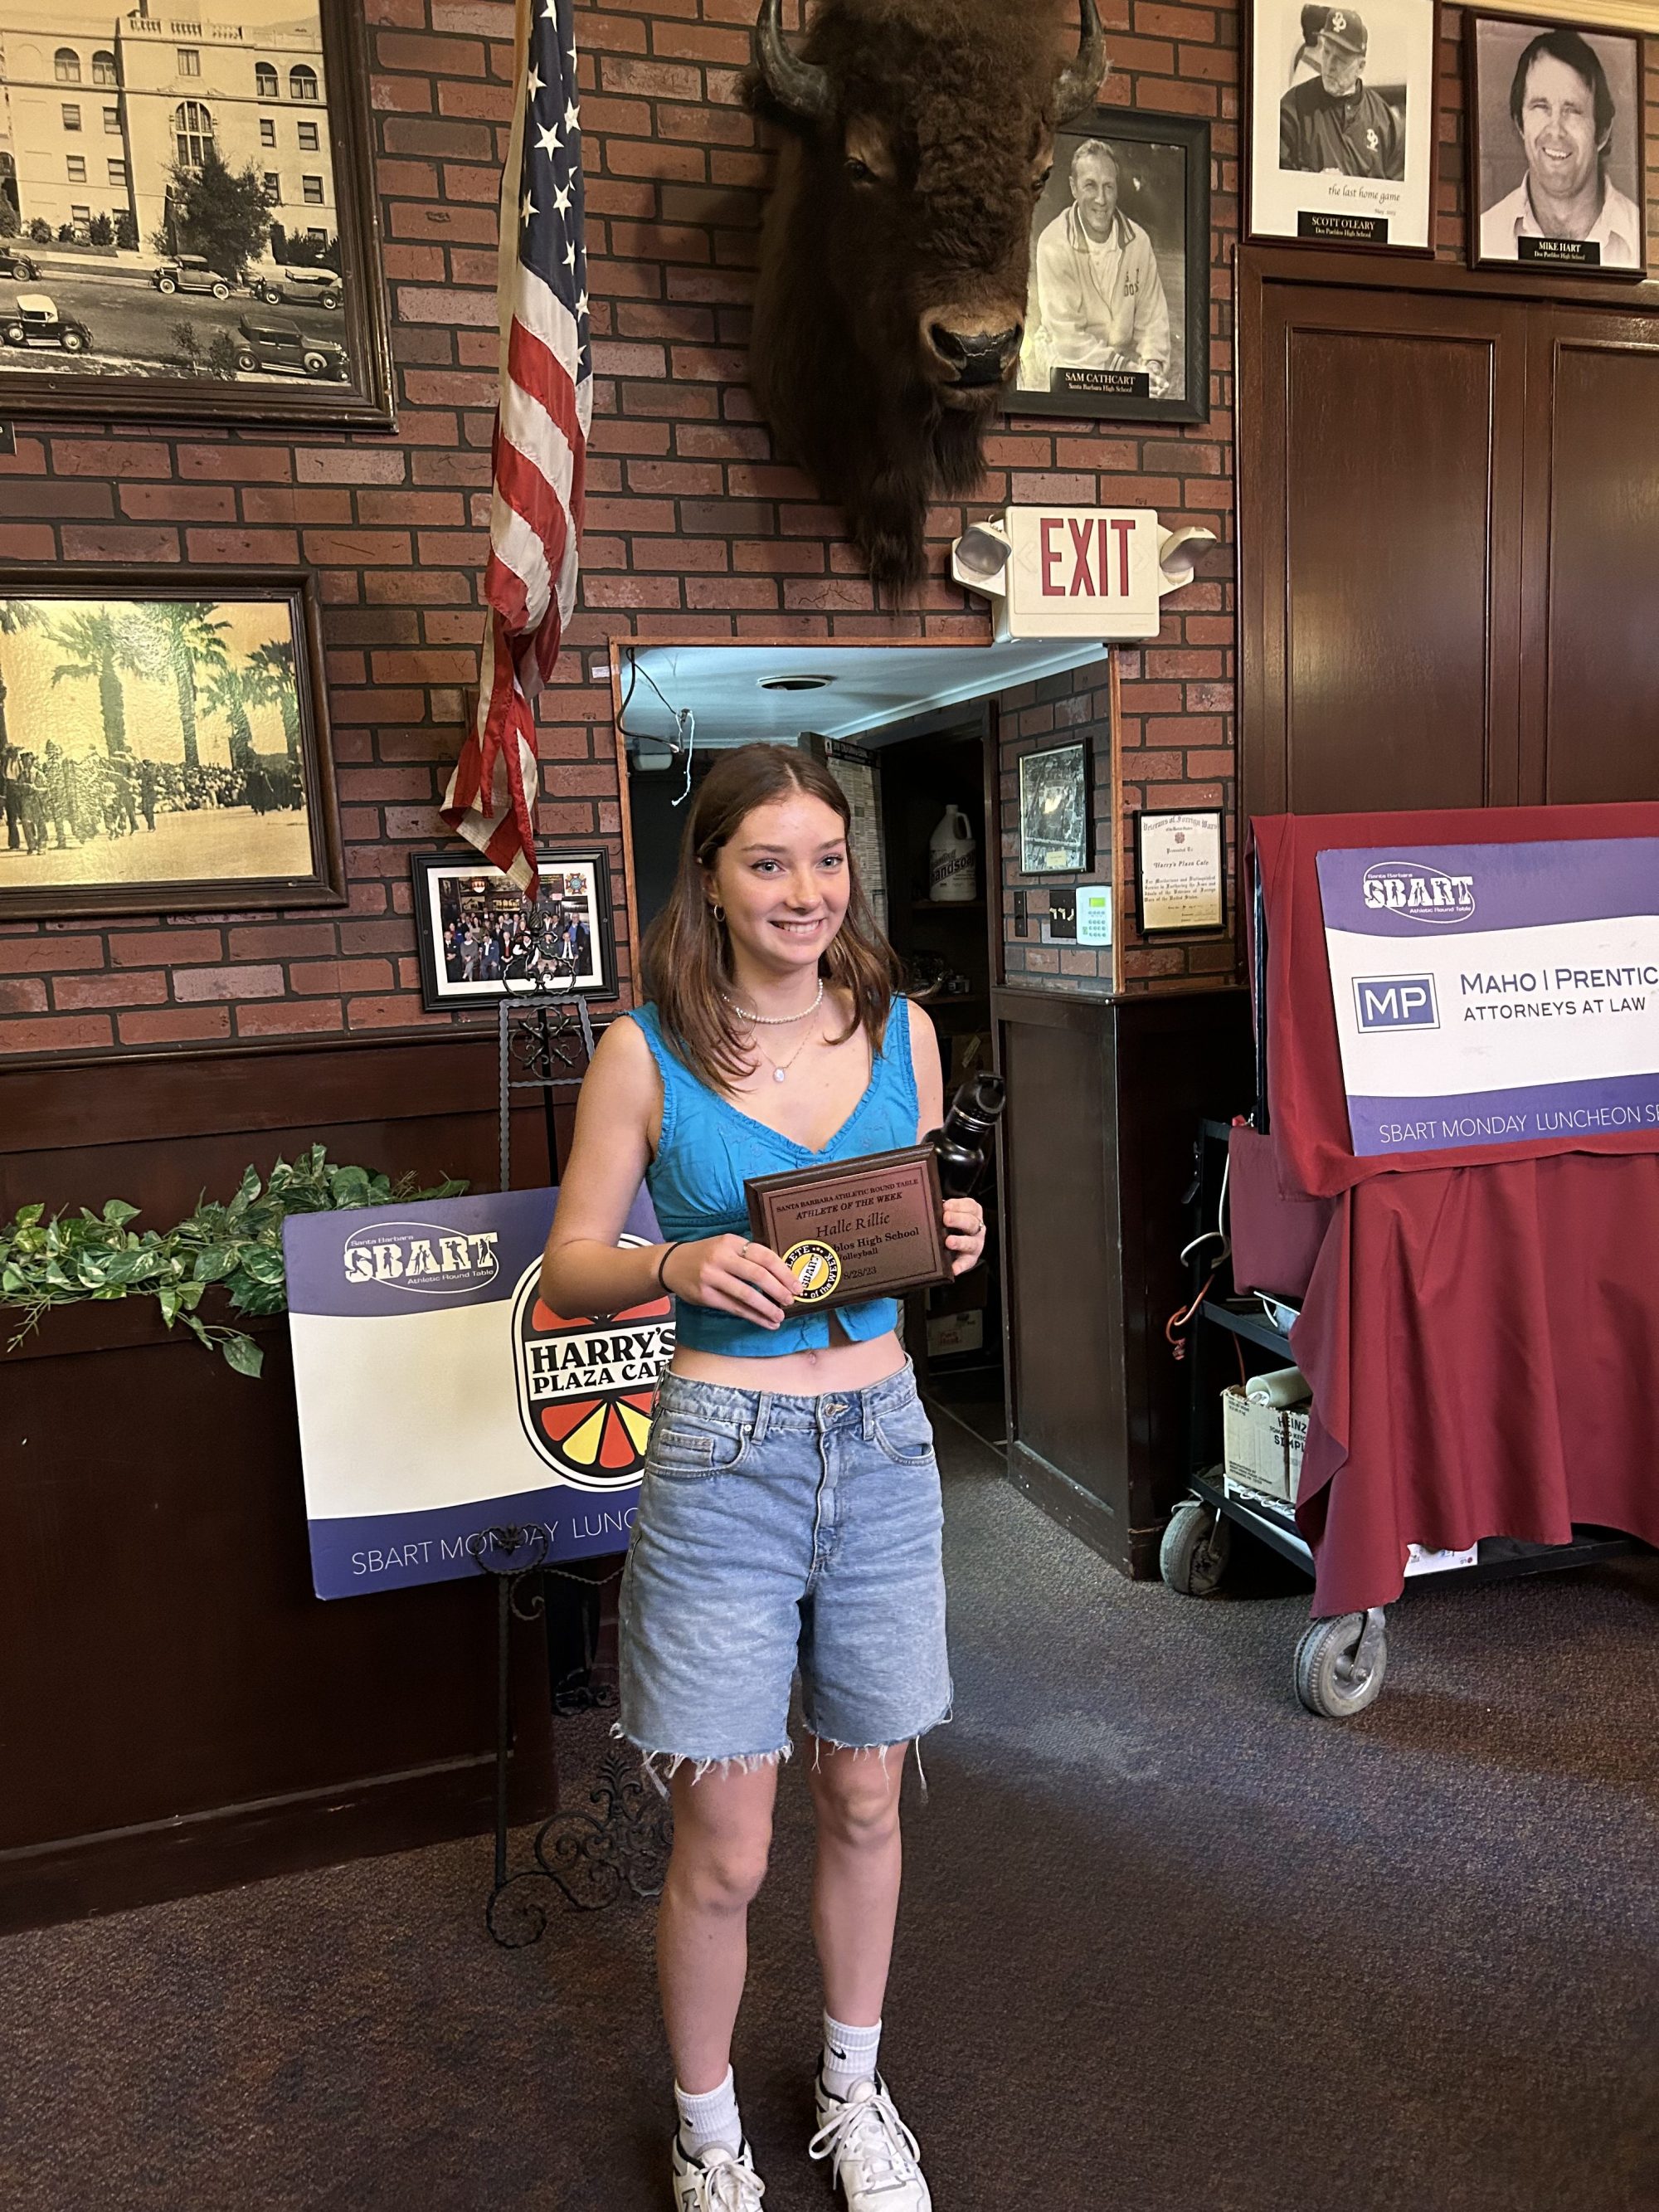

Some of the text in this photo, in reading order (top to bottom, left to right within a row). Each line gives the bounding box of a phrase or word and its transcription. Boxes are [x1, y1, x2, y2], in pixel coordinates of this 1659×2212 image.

[1328, 183, 1400, 204] the last home game
[1311, 216, 1375, 231] SCOTT O'LEARY
[1539, 241, 1581, 253] MIKE HART
[1065, 372, 1136, 385] SAM CATHCART
[1040, 518, 1136, 597] EXIT
[1363, 876, 1473, 909] SBART
[1364, 987, 1427, 1021] MP
[1463, 996, 1646, 1021] ATTORNEYS AT LAW
[1379, 1121, 1438, 1143] SBART
[1443, 1114, 1527, 1138] MONDAY
[1535, 1105, 1641, 1132] LUNCHEON
[776, 1179, 918, 1212] SANTA BARBARA ATHLETIC ROUND TABLE
[796, 1191, 903, 1220] ATHLETE OF THE WEEK
[815, 1212, 890, 1238] Halle Rillie
[350, 1235, 414, 1246] Santa Barbara
[833, 1227, 919, 1252] blos High School
[343, 1231, 498, 1284] SBART
[407, 1269, 494, 1284] Athletic Round Table
[786, 1245, 837, 1298] LETE of the WEEK
[843, 1266, 877, 1280] 8/28/23
[531, 1327, 676, 1374] HARRY'S
[533, 1358, 673, 1394] PLAZA CAF
[1269, 1425, 1306, 1442] TOMAO KETC
[1277, 1416, 1306, 1434] HEINZ
[1274, 1435, 1304, 1452] SIMPL
[352, 1541, 433, 1575] SBART
[572, 1507, 639, 1538] LUNC
